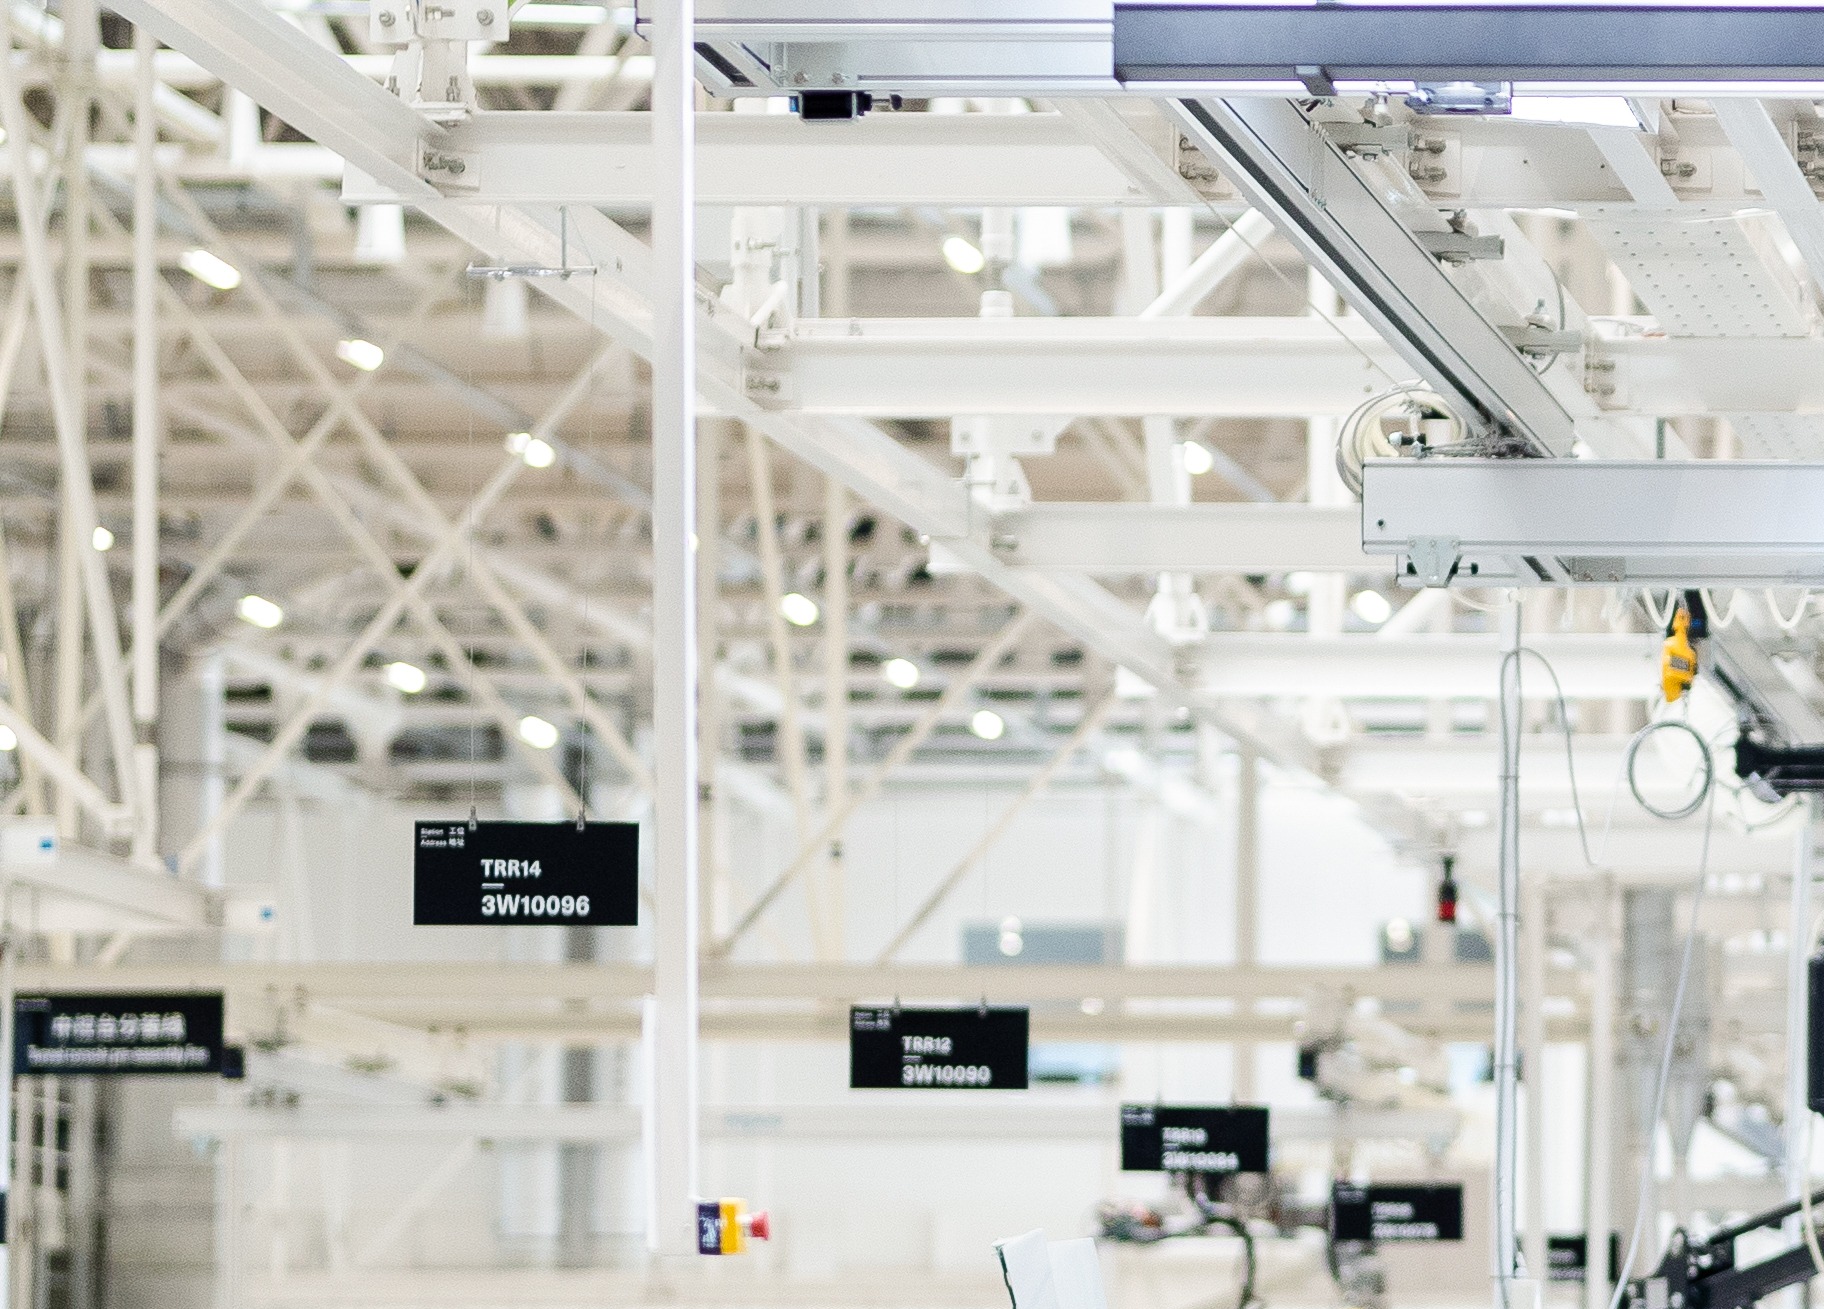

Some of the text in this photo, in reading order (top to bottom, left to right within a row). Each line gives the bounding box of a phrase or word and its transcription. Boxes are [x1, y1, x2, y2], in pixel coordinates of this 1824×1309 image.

[480, 858, 542, 878] TRR14
[481, 895, 591, 916] 3W10096
[901, 1035, 953, 1056] TRR12
[902, 1064, 993, 1086] 3W10090
